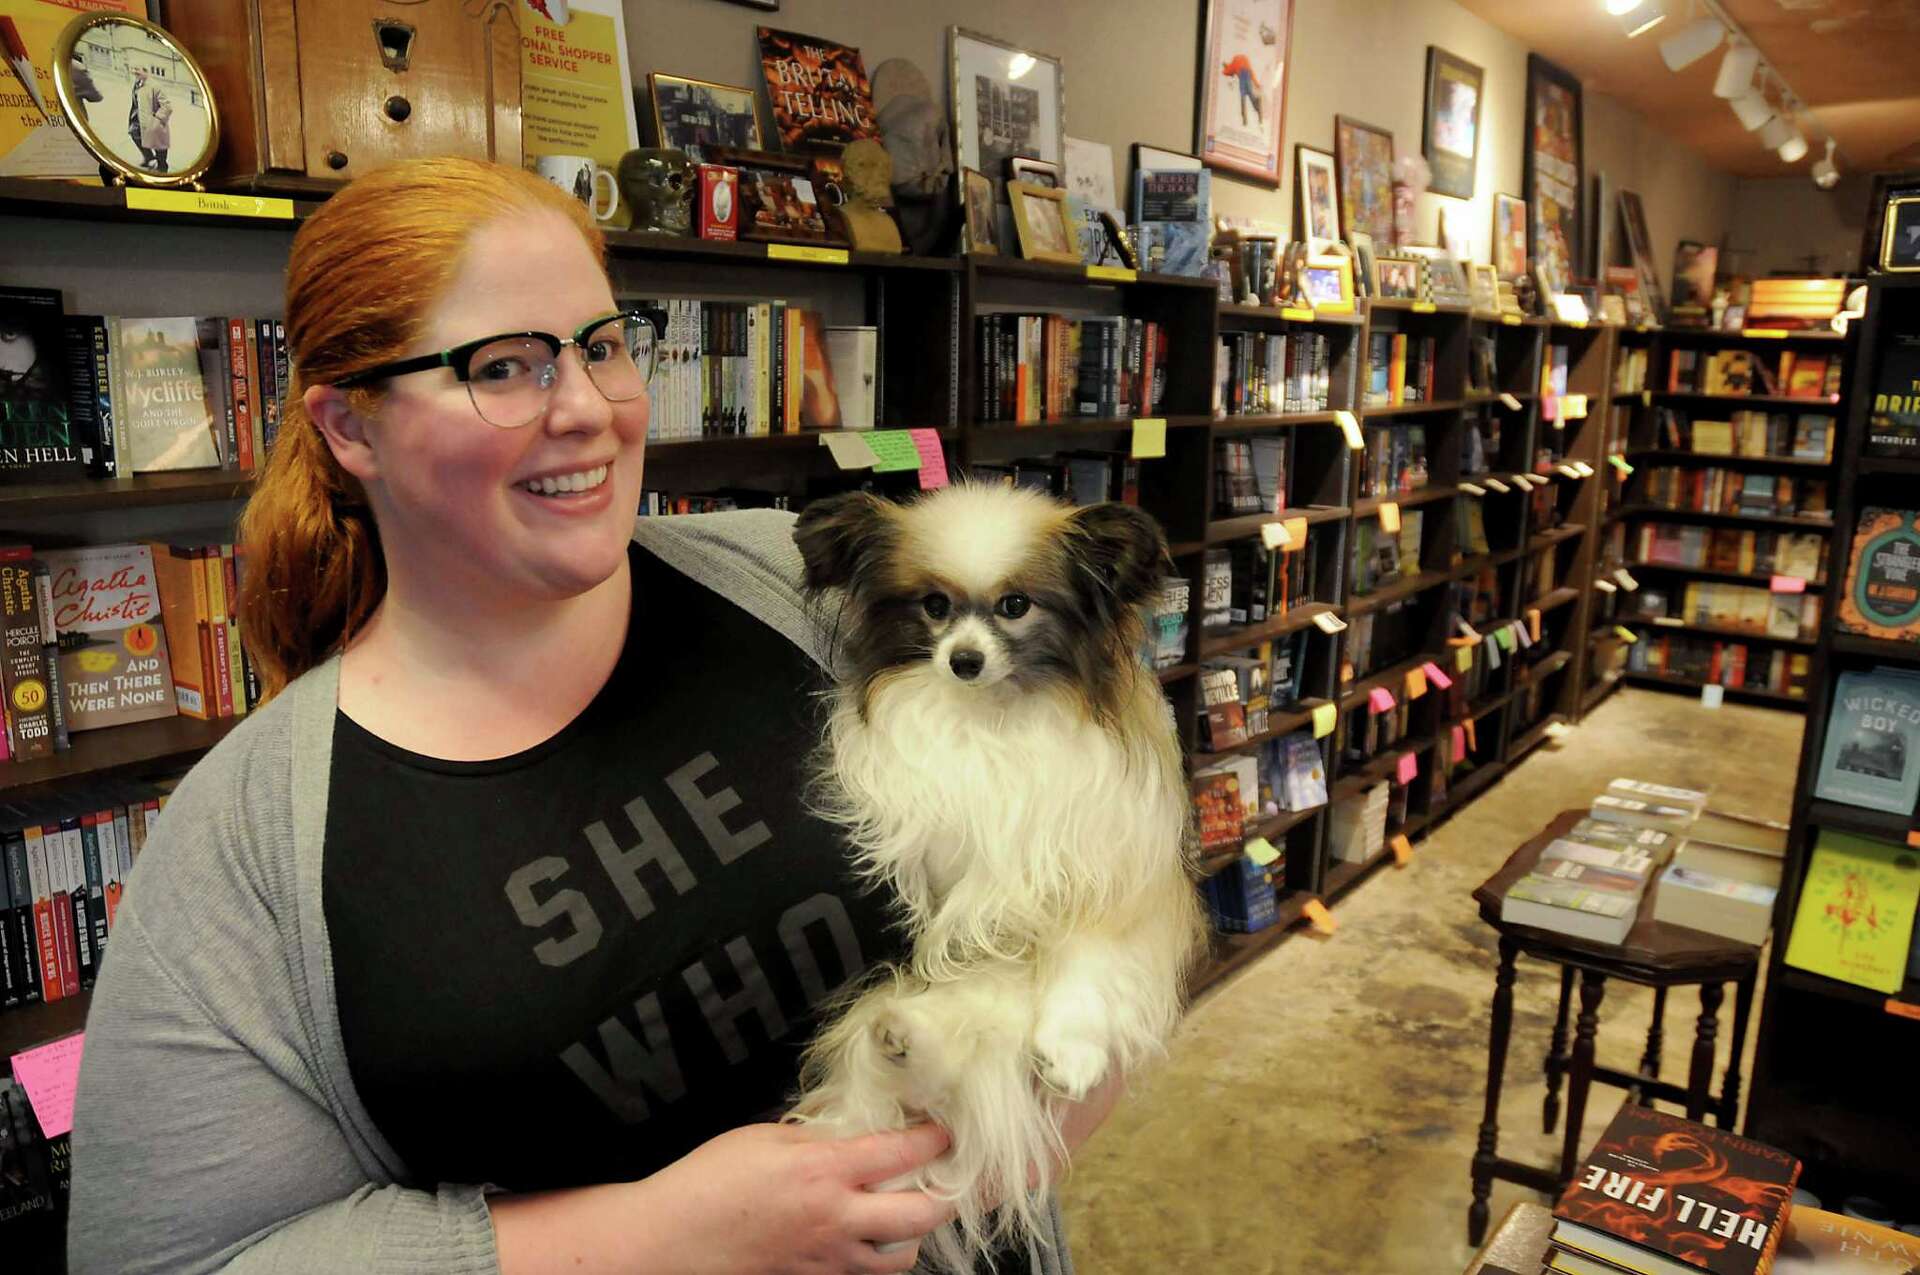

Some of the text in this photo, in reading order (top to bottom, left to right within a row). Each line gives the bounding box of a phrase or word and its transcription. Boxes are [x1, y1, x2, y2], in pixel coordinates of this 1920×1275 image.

[535, 26, 565, 41] FREE
[522, 37, 612, 64] ONAL SHOPPER
[530, 53, 578, 72] SERVICE
[803, 45, 825, 59] THE
[776, 59, 858, 97] BRUTAL
[779, 91, 870, 128] TELLING
[93, 326, 108, 392] KEN BRUEN
[125, 381, 204, 408] Wycliffe
[1875, 394, 1920, 414] DRIF
[25, 446, 77, 463] HELL
[2, 567, 15, 615] Christie
[16, 569, 32, 611] Agatha
[52, 567, 146, 601] Agatha
[55, 592, 152, 628] Christie
[5, 625, 39, 638] HERCULE
[6, 635, 41, 649] POIROT
[126, 658, 159, 673] AND
[22, 689, 39, 705] 50
[68, 673, 162, 697] THEN THERE
[70, 690, 165, 713] WERE NONE
[1844, 697, 1920, 725] WICKED
[19, 719, 48, 729] CHARLES
[20, 726, 49, 740] TODD
[1861, 714, 1898, 733] BOY
[504, 751, 773, 967] SHE
[559, 892, 865, 1124] WHO
[1579, 1165, 1768, 1250] HELL FIRE
